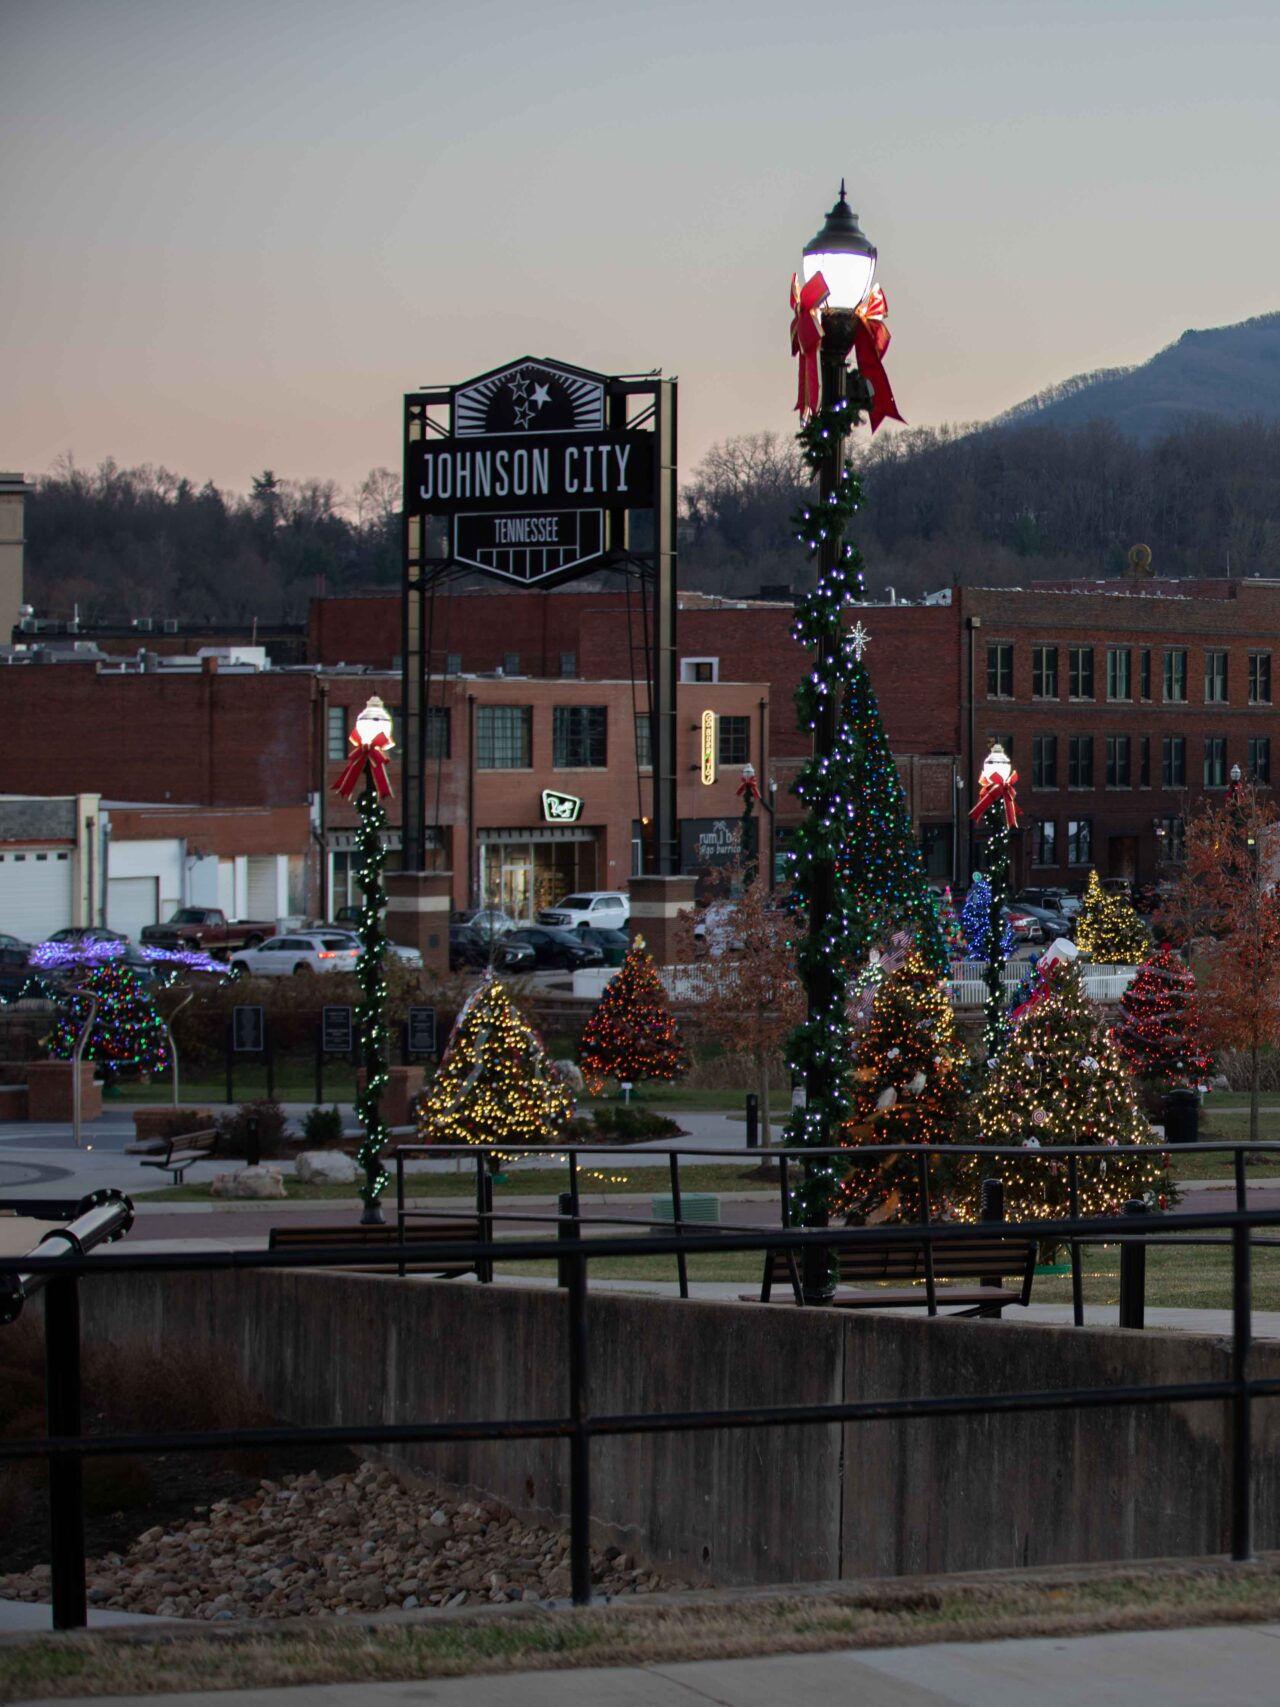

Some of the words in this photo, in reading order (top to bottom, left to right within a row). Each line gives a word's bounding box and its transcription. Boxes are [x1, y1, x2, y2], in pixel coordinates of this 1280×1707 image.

[420, 448, 549, 499] JOHNSON
[564, 444, 631, 493] CITY
[494, 517, 559, 543] TENNESSEE
